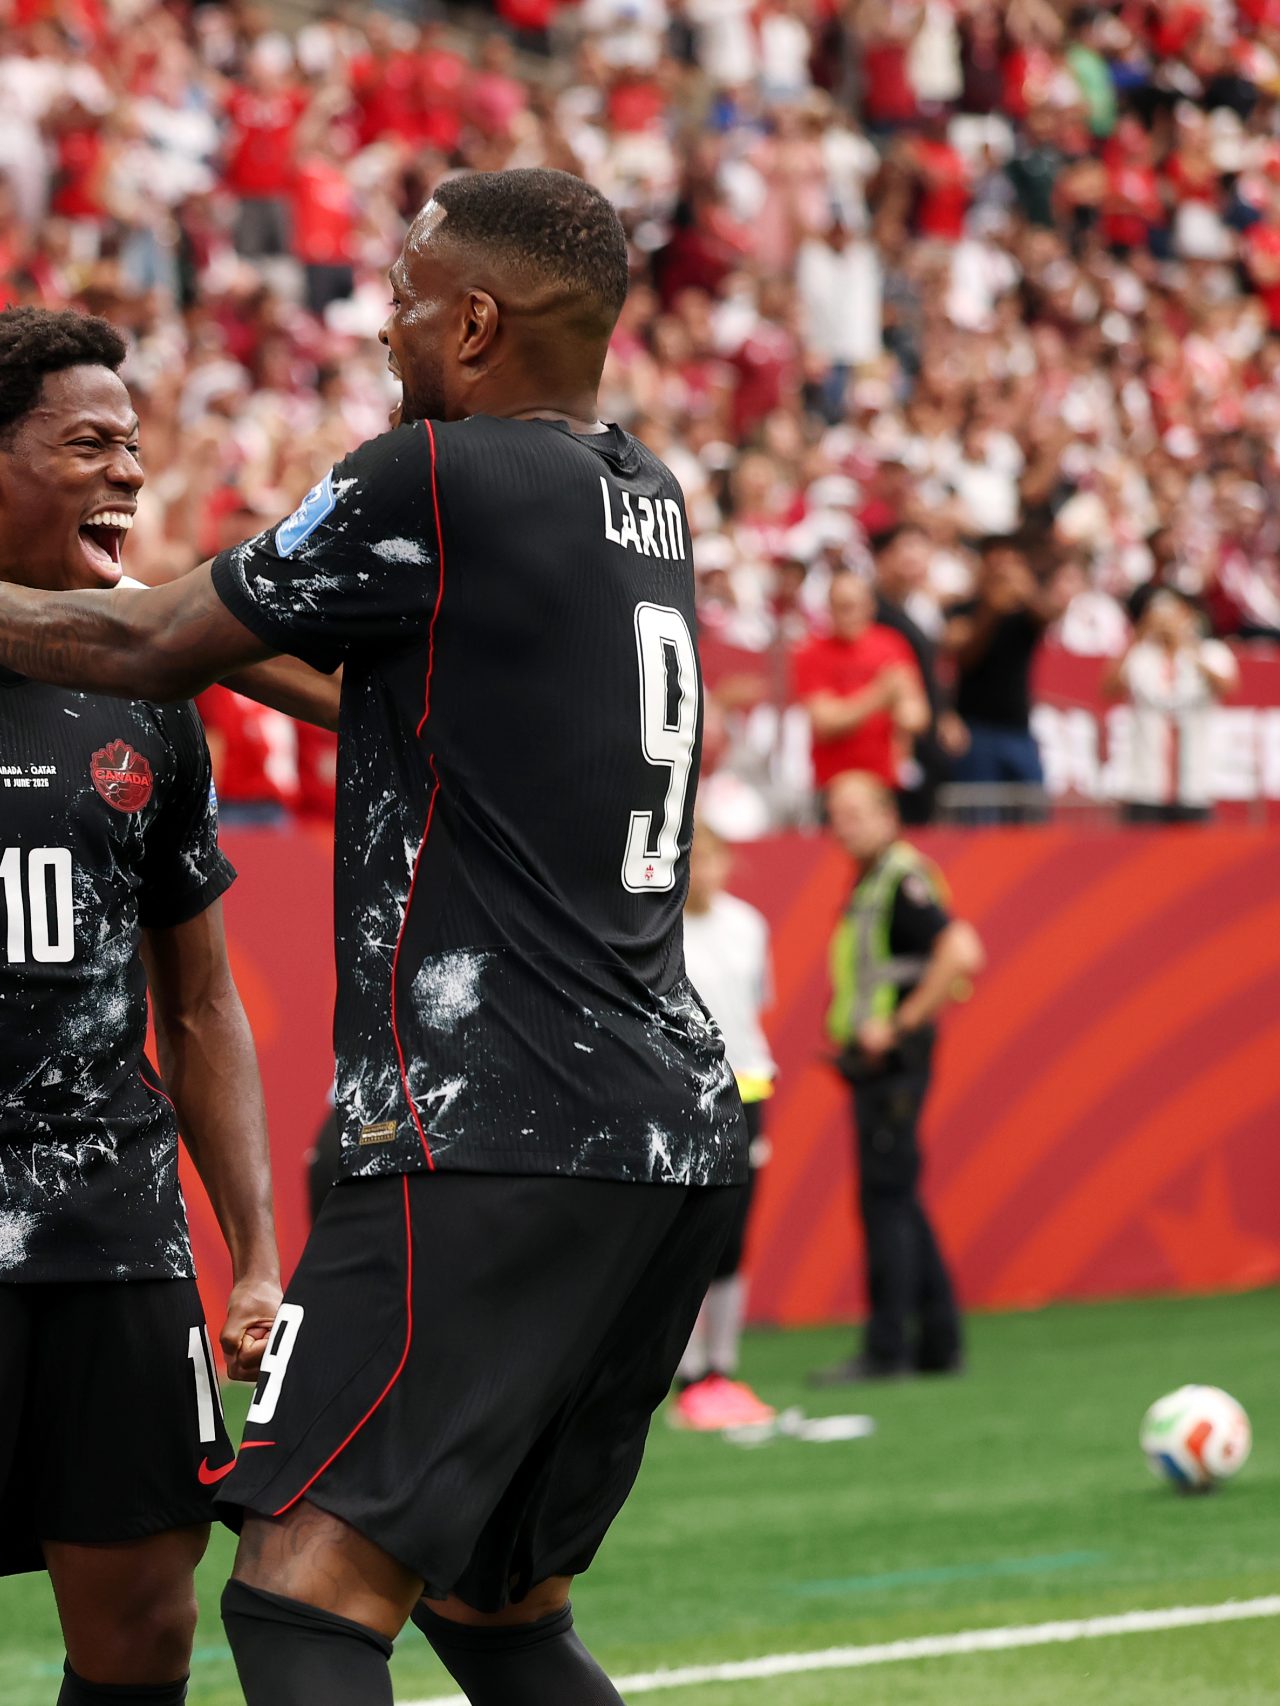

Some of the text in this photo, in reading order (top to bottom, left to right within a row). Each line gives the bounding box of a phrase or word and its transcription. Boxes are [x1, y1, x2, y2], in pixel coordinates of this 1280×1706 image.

[600, 476, 685, 560] LARIN
[30, 765, 57, 775] QATAR
[621, 601, 699, 893] 9
[13, 778, 31, 788] JUNE
[32, 778, 49, 788] 2026
[94, 769, 149, 787] CANADA
[246, 1303, 304, 1424] 9
